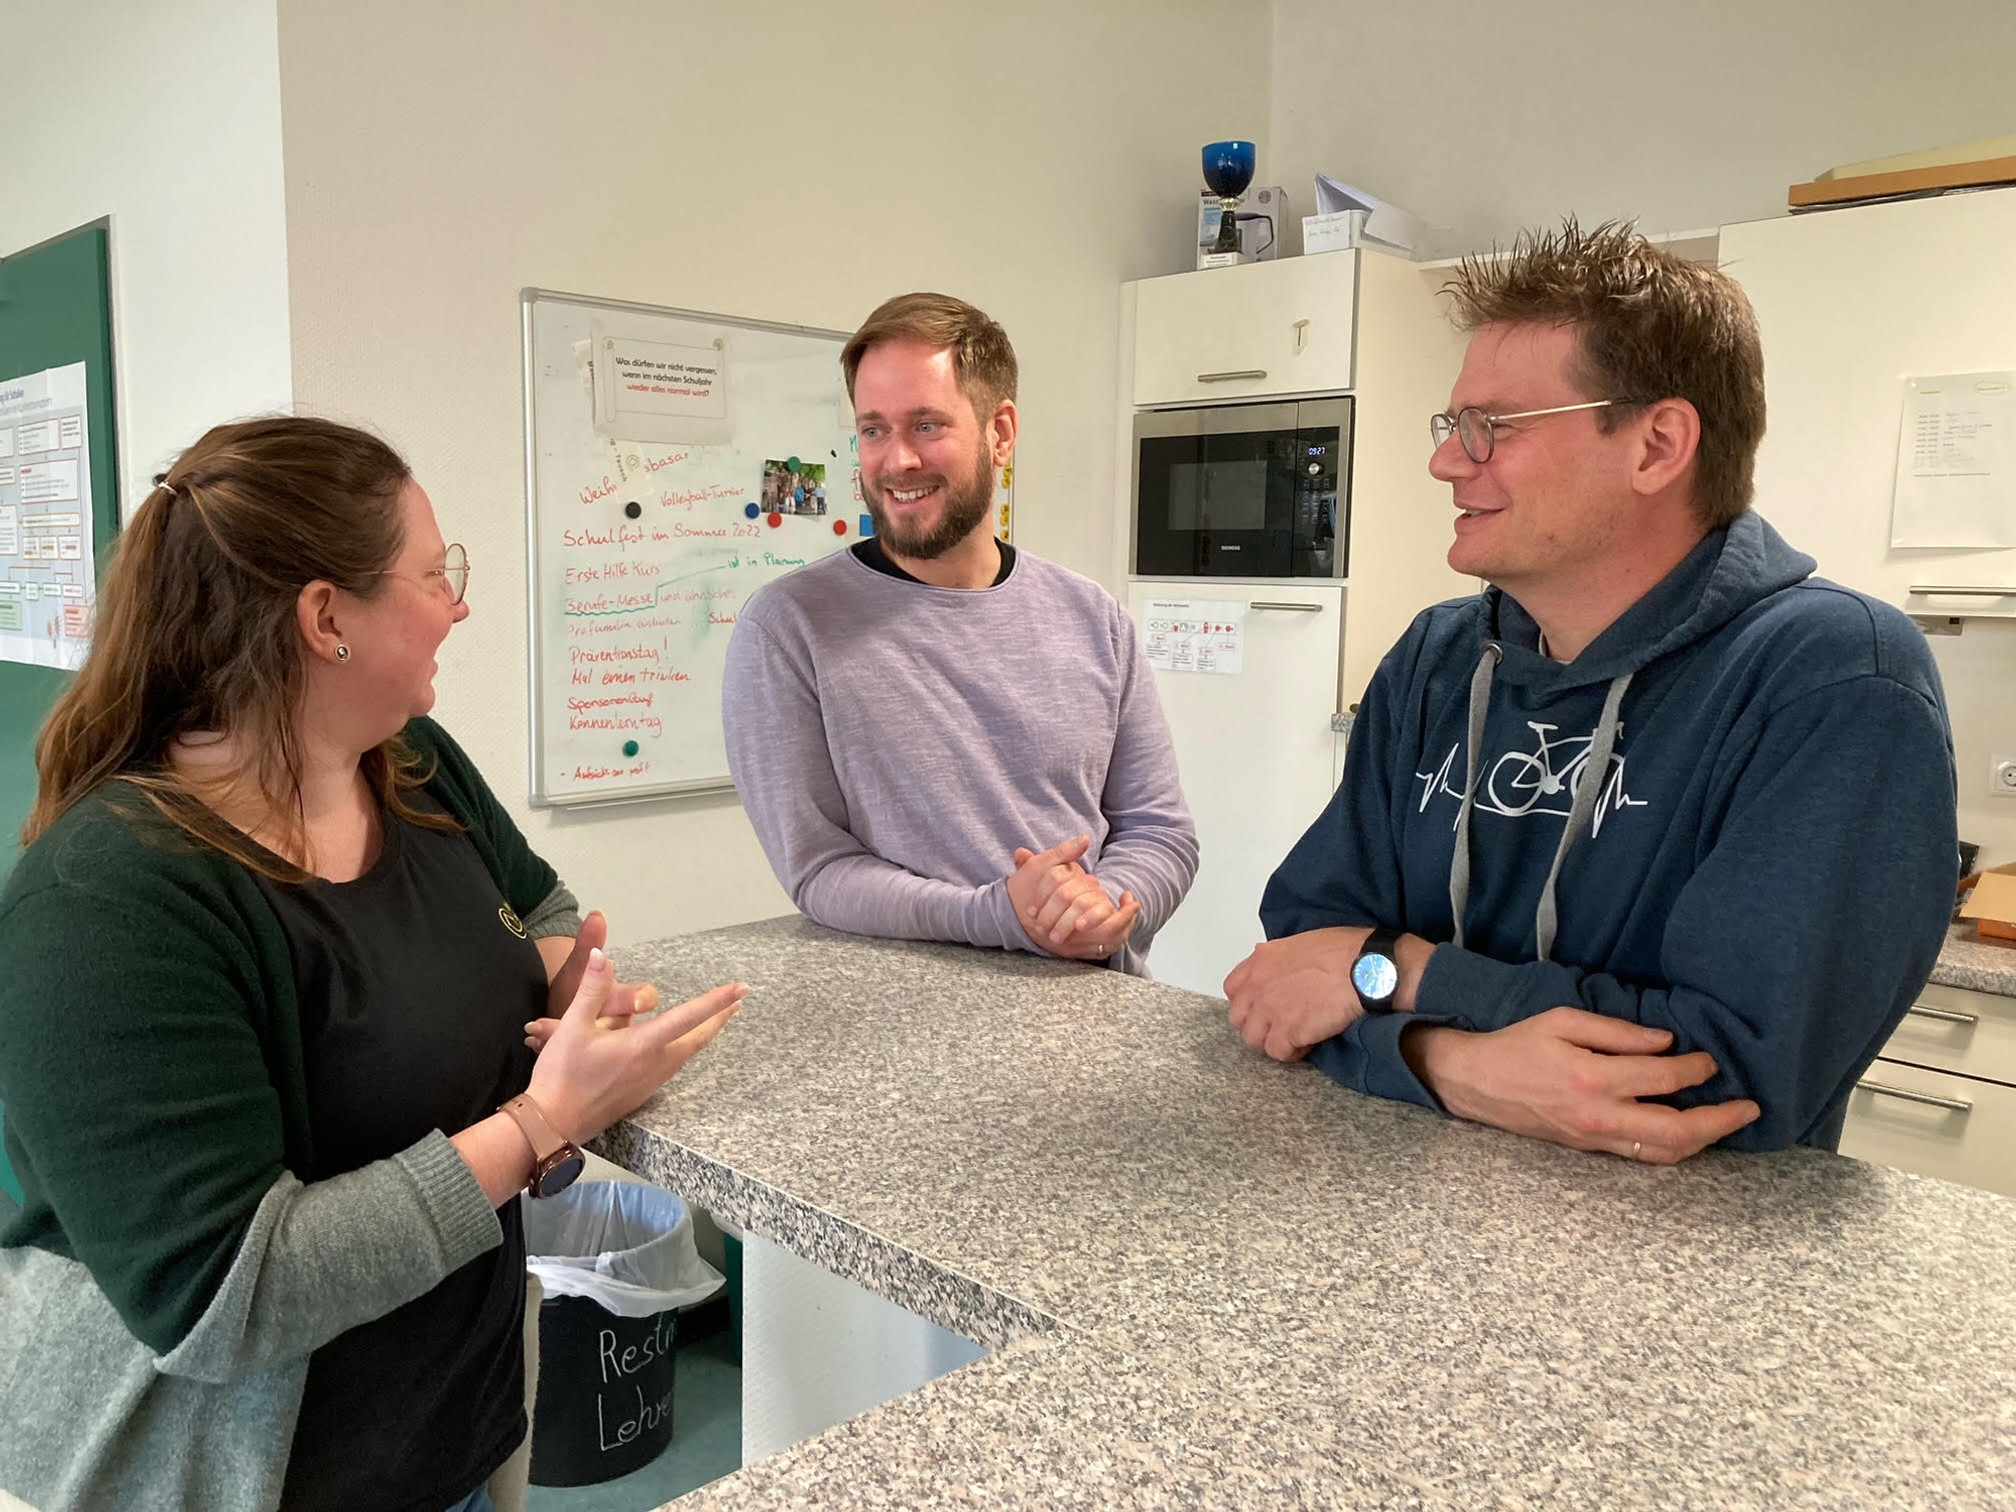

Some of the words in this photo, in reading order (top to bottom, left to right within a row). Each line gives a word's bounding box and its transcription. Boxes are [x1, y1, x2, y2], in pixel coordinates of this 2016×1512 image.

[616, 357, 631, 366] Was
[632, 359, 655, 369] dürfen
[656, 362, 667, 370] wir
[668, 363, 684, 372] nicht
[685, 365, 718, 376] vergessen,
[622, 371, 642, 379] wenn
[642, 372, 652, 380] im
[653, 373, 682, 384] nächsten
[683, 375, 713, 387] Schuljahr
[627, 383, 650, 392] wieder
[651, 385, 666, 394] alles
[667, 387, 690, 396] normal
[692, 389, 710, 397] wird?
[660, 484, 745, 511] Volleyball-Turnier
[652, 526, 669, 542] im
[674, 521, 726, 539] Sommer
[732, 521, 761, 539] 2022
[565, 567, 599, 585] Erste
[603, 563, 628, 580] Hilfe
[632, 559, 660, 577] Kurs
[569, 642, 659, 668] Präventionstag
[572, 667, 592, 685] Mal
[602, 670, 635, 686] einen
[639, 667, 691, 684] trinken
[569, 711, 663, 739] Kennenlerntag
